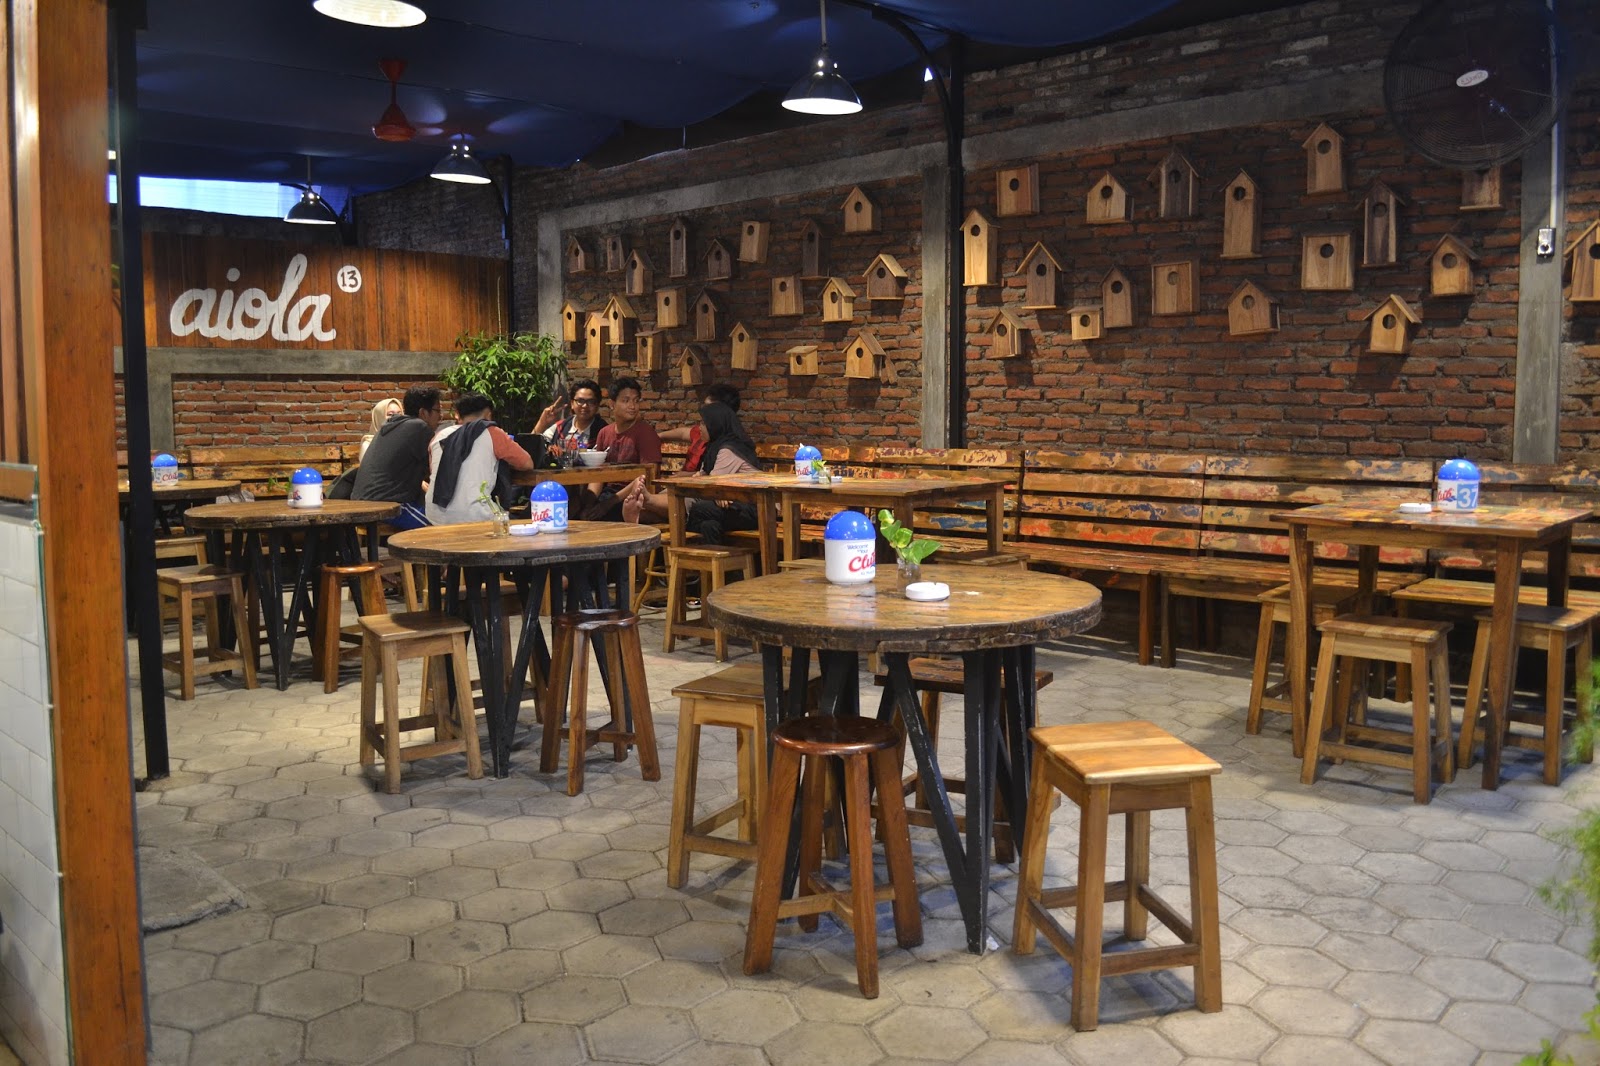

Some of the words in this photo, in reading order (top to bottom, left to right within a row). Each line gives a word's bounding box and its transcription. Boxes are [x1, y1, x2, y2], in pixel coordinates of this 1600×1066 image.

[339, 267, 361, 290] 13
[170, 253, 337, 342] aiola
[1457, 487, 1479, 508] 37
